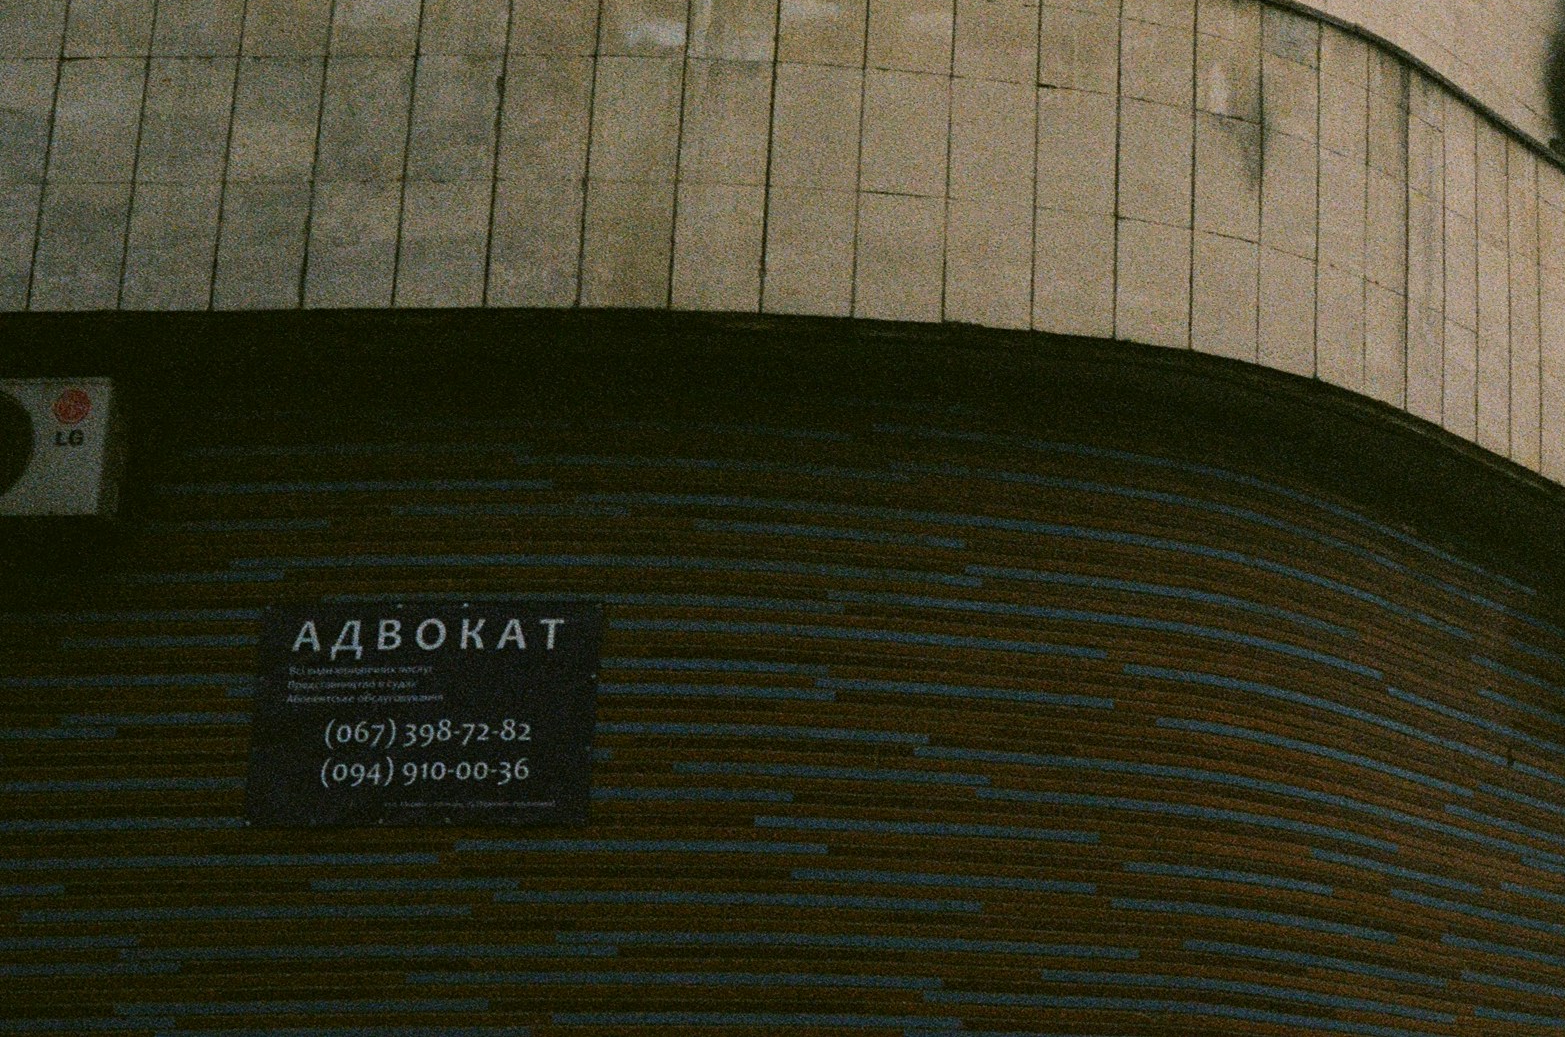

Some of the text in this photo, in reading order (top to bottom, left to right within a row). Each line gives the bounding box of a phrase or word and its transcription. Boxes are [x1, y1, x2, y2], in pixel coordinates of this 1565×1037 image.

[55, 429, 84, 448] LG
[291, 617, 566, 661] АДВОКАТ
[325, 718, 532, 749] (067) 398-72-82
[320, 756, 530, 788] (094) 910-00-36
